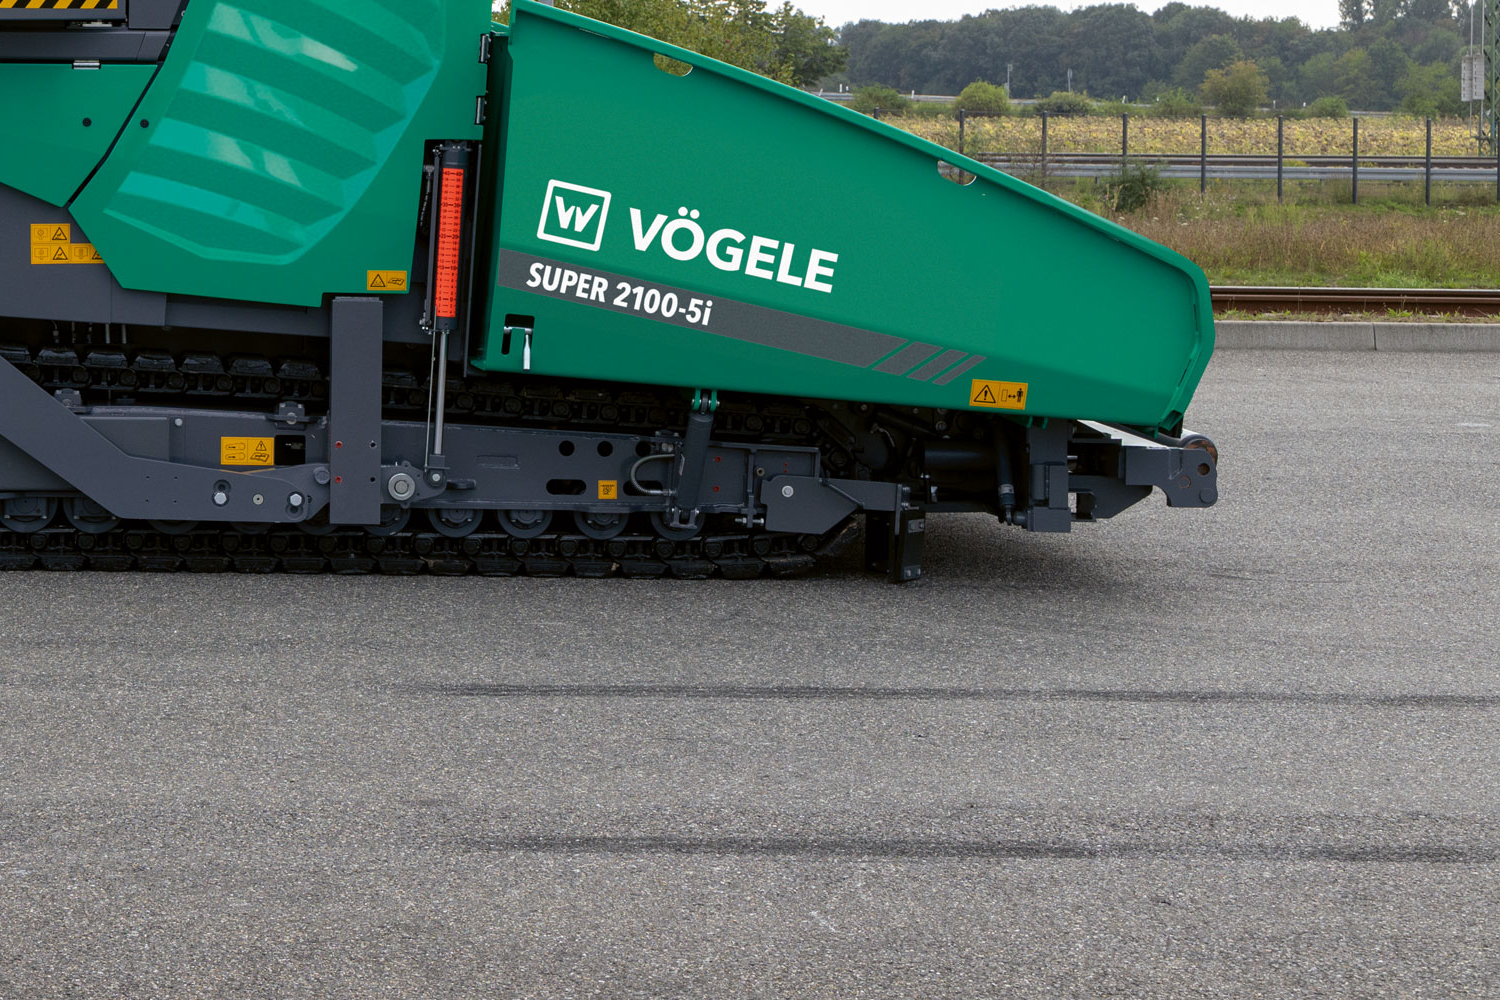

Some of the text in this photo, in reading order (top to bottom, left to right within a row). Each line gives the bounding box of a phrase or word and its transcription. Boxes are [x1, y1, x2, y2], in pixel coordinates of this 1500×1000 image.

[629, 206, 840, 295] VÖGELE
[525, 262, 713, 327] SUPER 2100-5i
